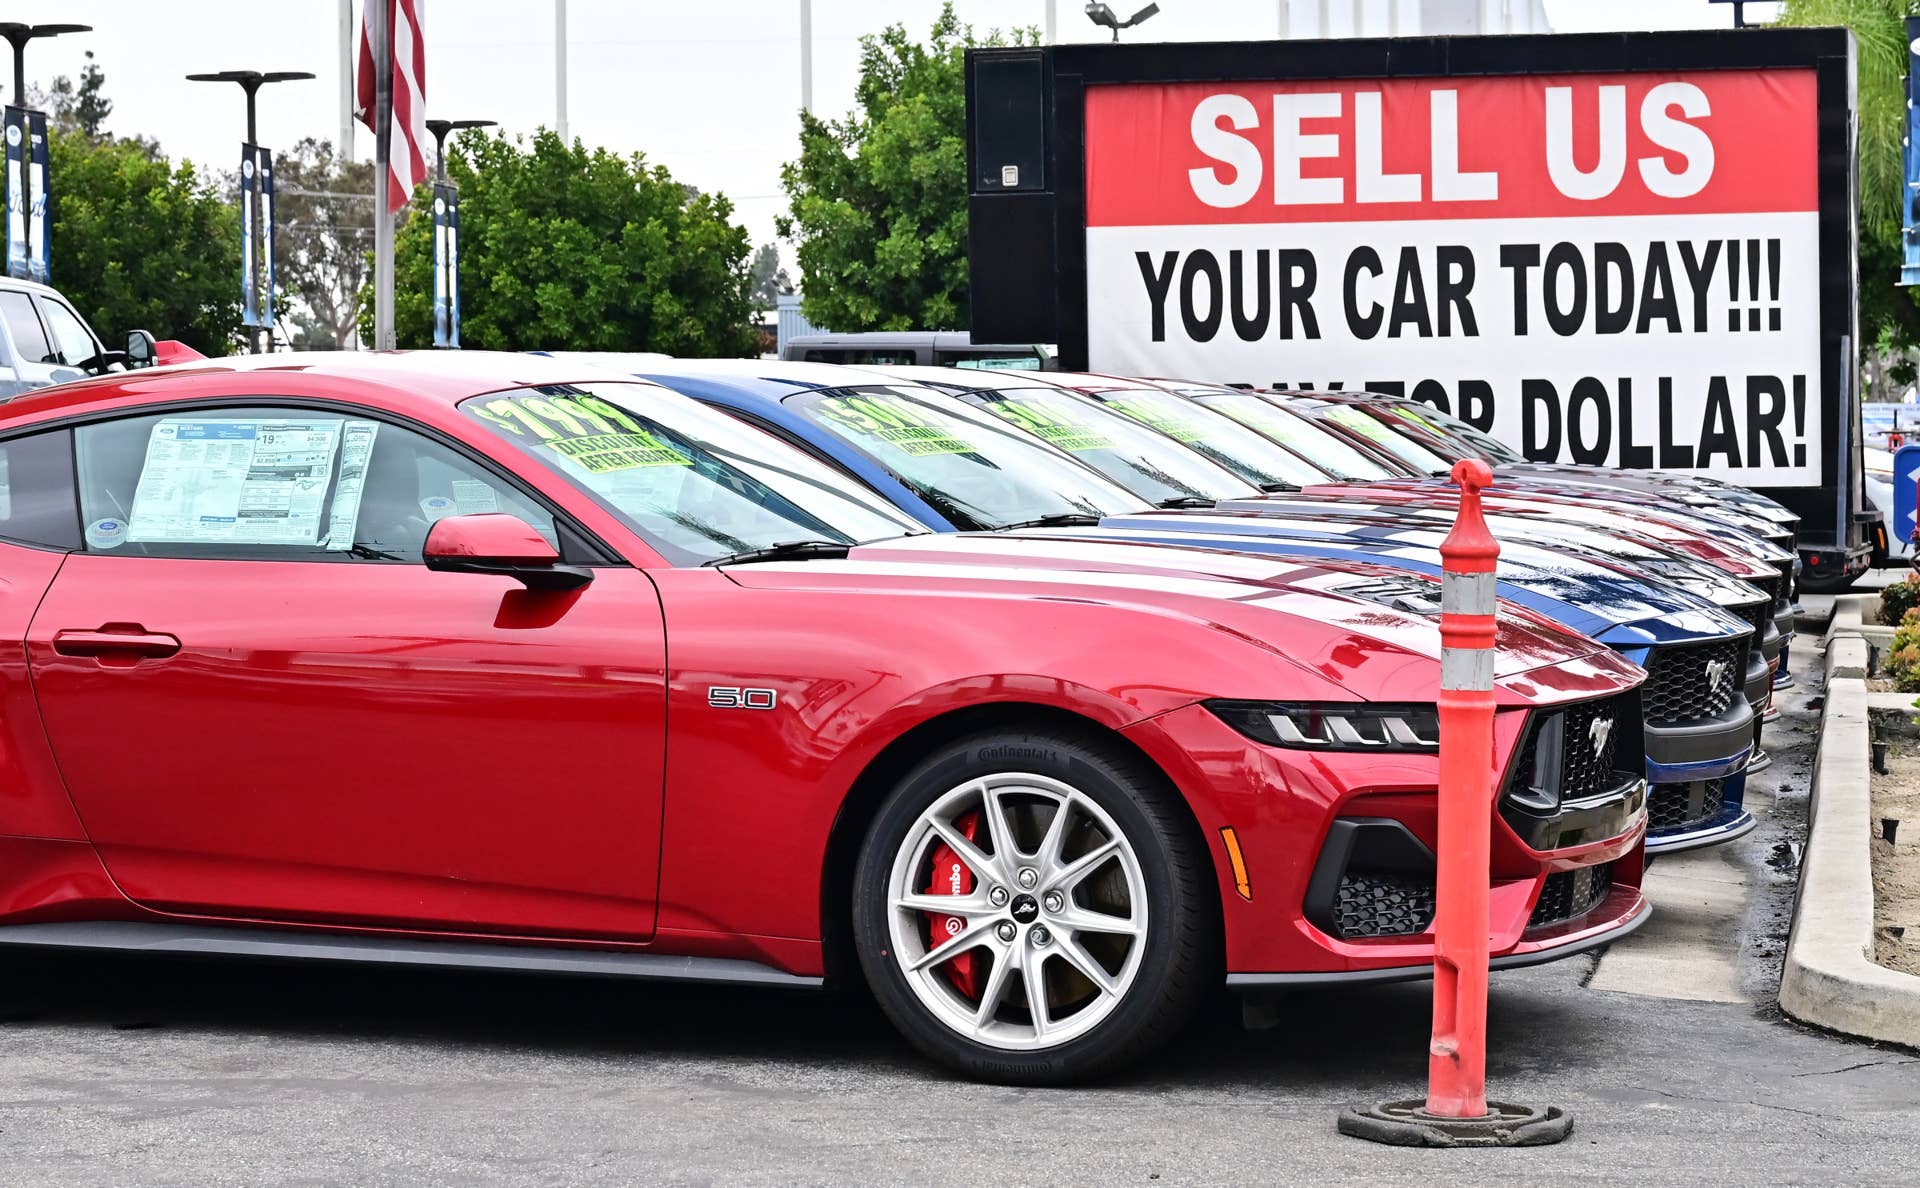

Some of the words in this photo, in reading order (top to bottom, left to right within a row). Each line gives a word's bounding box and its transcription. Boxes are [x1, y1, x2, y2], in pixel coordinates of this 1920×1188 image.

[1188, 89, 1498, 209] SELL
[1545, 82, 1716, 200] US
[1135, 248, 1322, 342] YOUR
[1343, 245, 1480, 340] CAR
[1500, 238, 1782, 337] TODAY!!!
[466, 393, 648, 441] $7999
[1521, 374, 1806, 469] DOLLAR!
[262, 434, 275, 444] 19
[554, 433, 656, 456] DISCOUNT
[578, 451, 631, 472] AFTER
[627, 449, 684, 465] REBATE
[977, 743, 1048, 761] Continental
[949, 863, 961, 896] mbo
